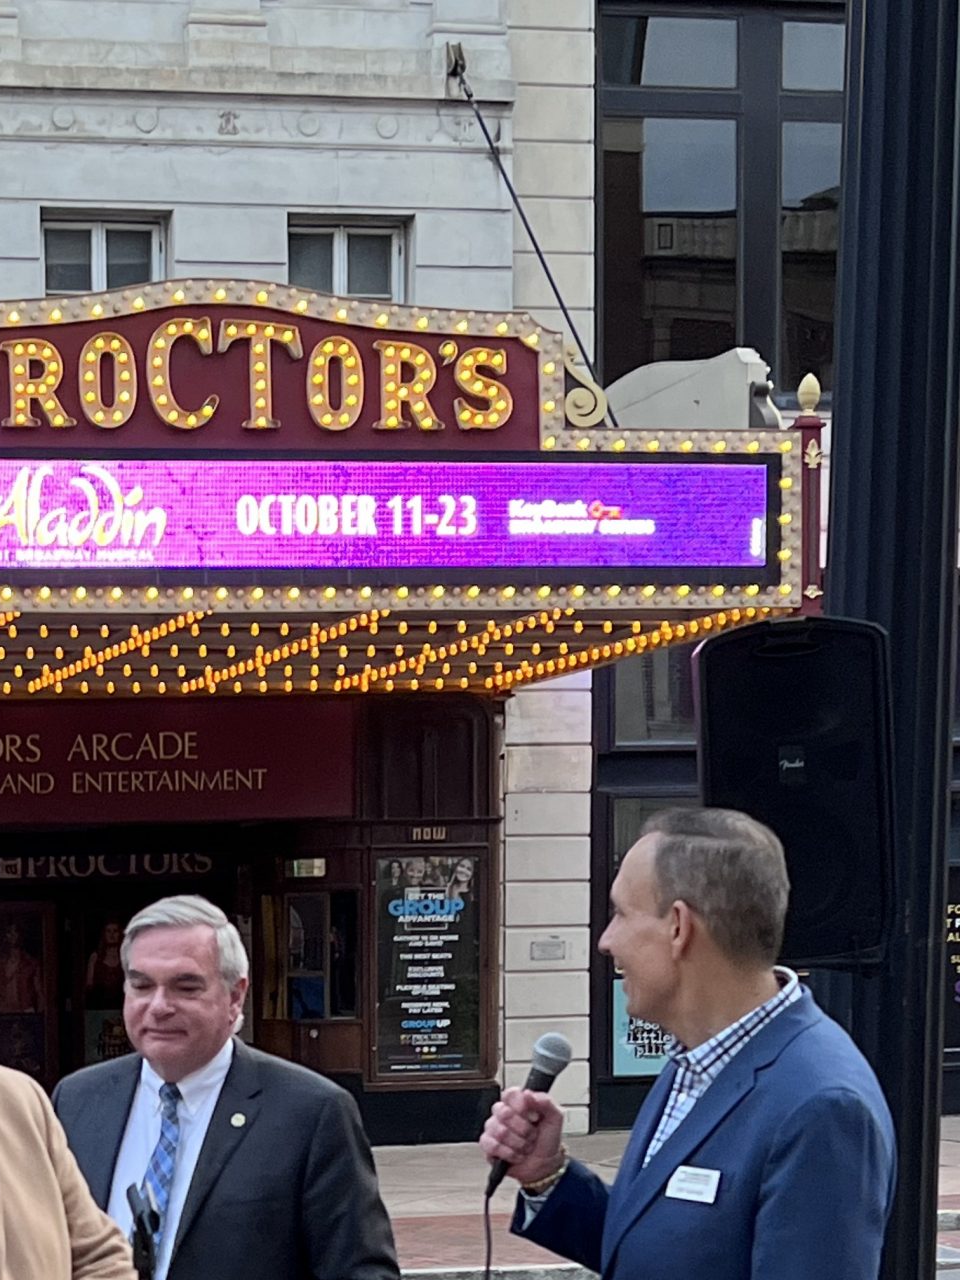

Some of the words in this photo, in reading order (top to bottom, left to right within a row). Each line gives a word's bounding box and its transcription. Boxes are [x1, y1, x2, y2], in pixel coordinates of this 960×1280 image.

[237, 494, 378, 537] OCTOBER
[387, 494, 477, 536] 11-23
[68, 731, 199, 762] ARCADE
[0, 771, 55, 795] AND
[72, 768, 268, 795] ENTERTAINMENT
[27, 853, 214, 878] PROCTORS
[388, 898, 465, 917] GROUP
[627, 1030, 674, 1044] little
